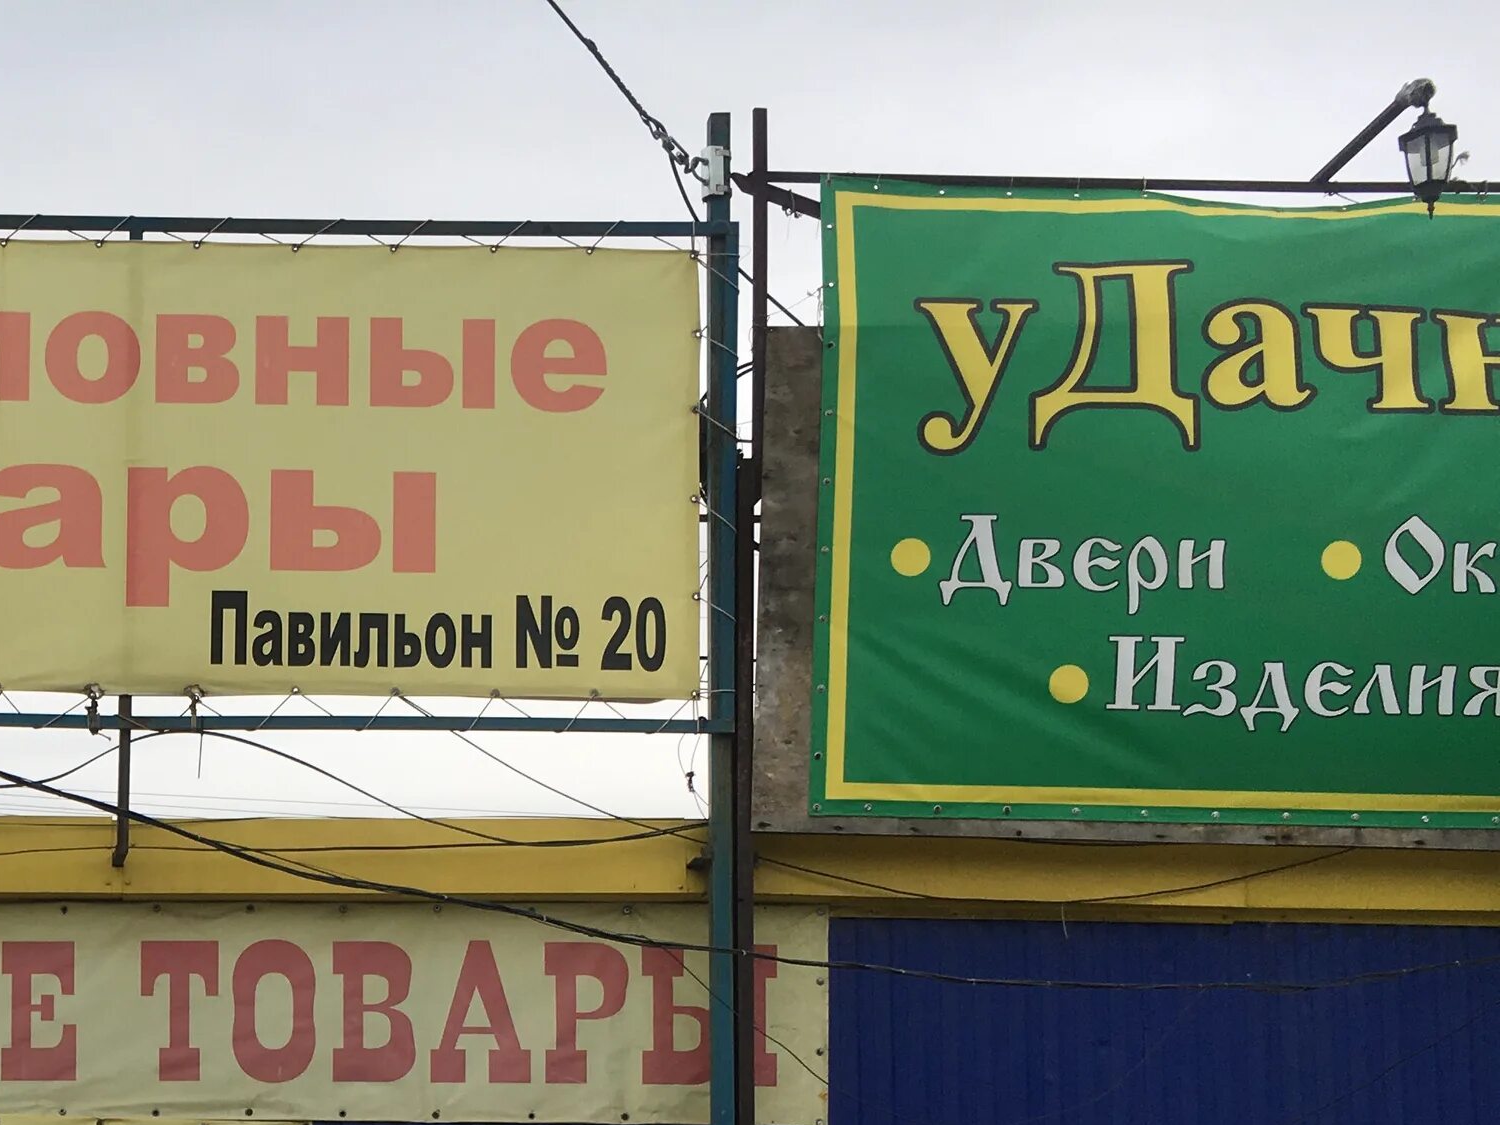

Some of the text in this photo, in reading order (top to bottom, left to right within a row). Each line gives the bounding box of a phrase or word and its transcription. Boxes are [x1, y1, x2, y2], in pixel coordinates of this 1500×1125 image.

[937, 512, 1498, 615] Двери Ок
[210, 590, 667, 673] Павильон № 20
[1105, 635, 1500, 732] Изделия
[140, 938, 778, 1087] ТОВАРЫ
